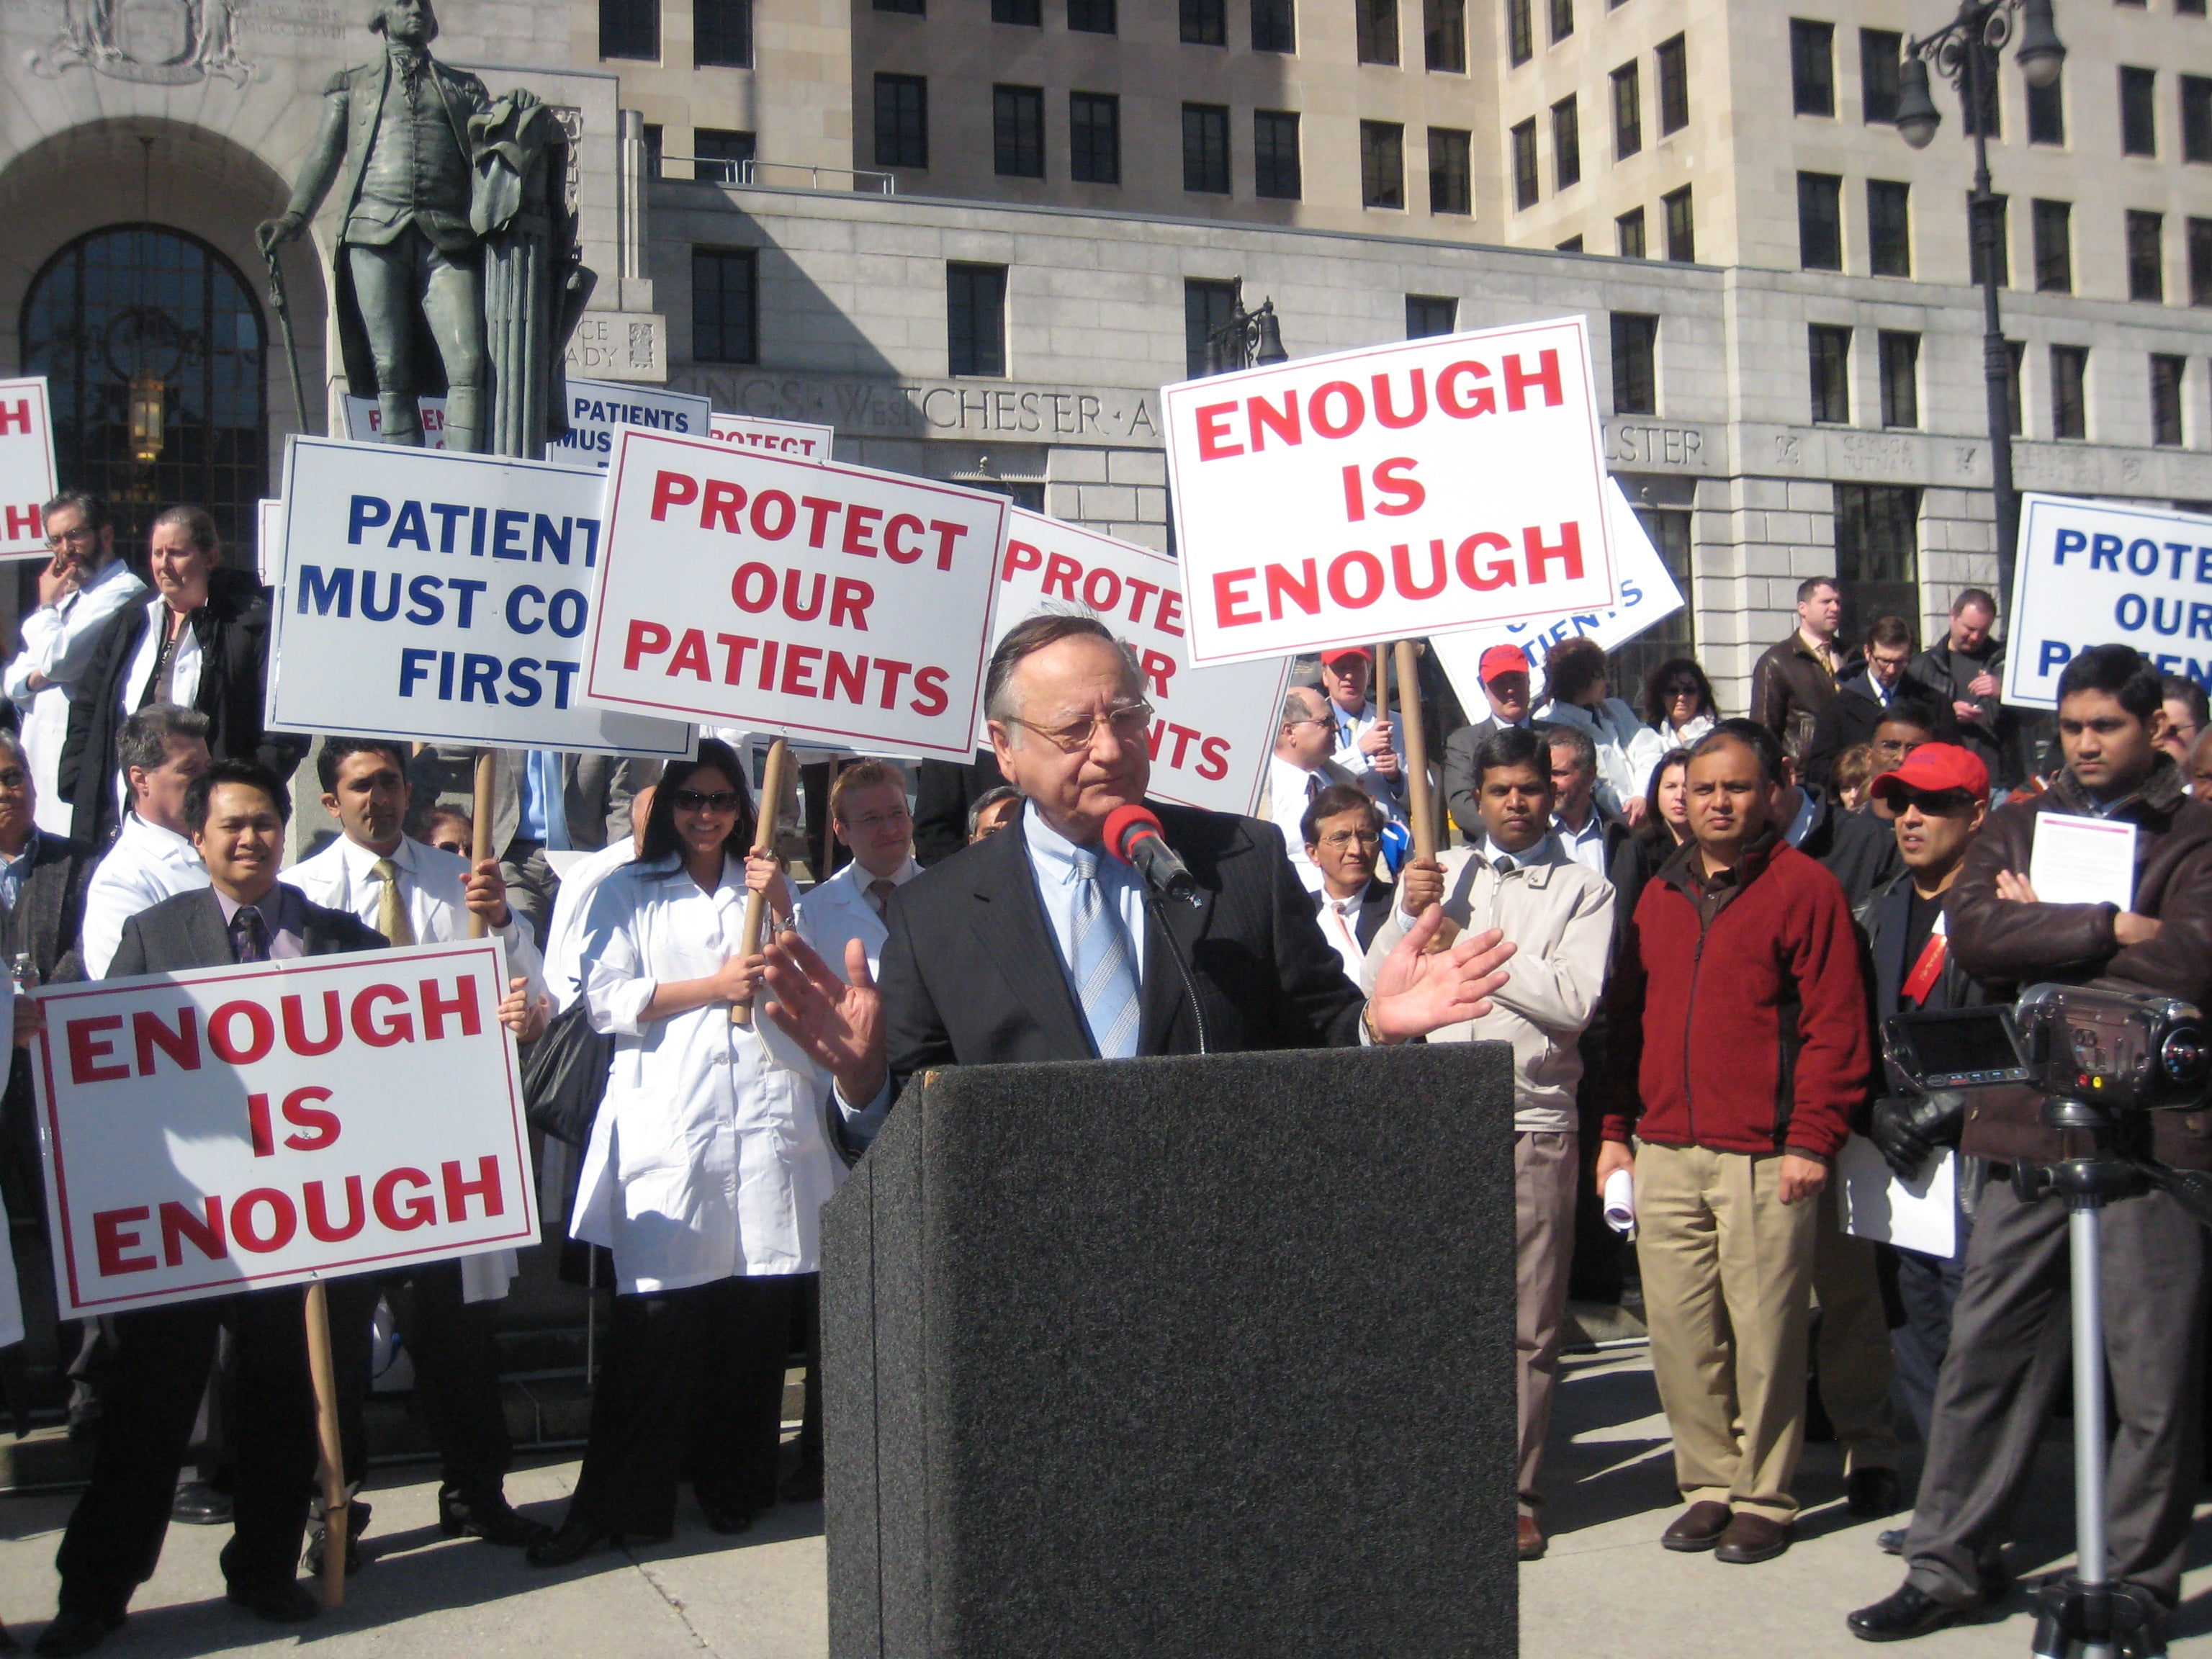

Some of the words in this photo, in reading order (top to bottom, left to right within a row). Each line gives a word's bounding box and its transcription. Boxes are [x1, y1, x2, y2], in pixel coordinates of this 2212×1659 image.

[557, 428, 611, 452] MUS
[574, 397, 688, 433] PATIENTS
[1195, 349, 1565, 462] ENOUGH
[1601, 423, 1708, 468] LSTER
[651, 469, 968, 571] PROTECT
[1342, 457, 1426, 522] IS
[348, 495, 601, 568] PATIENT
[2054, 528, 2212, 584] PROTE
[297, 565, 487, 629] MUST
[505, 585, 589, 639] CO
[732, 562, 874, 631] OUR
[1001, 539, 1185, 637] PROTE
[1212, 521, 1585, 629] ENOUGH
[2114, 593, 2212, 641] OUR
[398, 648, 580, 710] FIRST
[624, 619, 950, 717] PATIENTS
[66, 974, 482, 1085] ENOUGH
[248, 1086, 342, 1157] IS
[93, 1155, 505, 1277] ENOUGH
